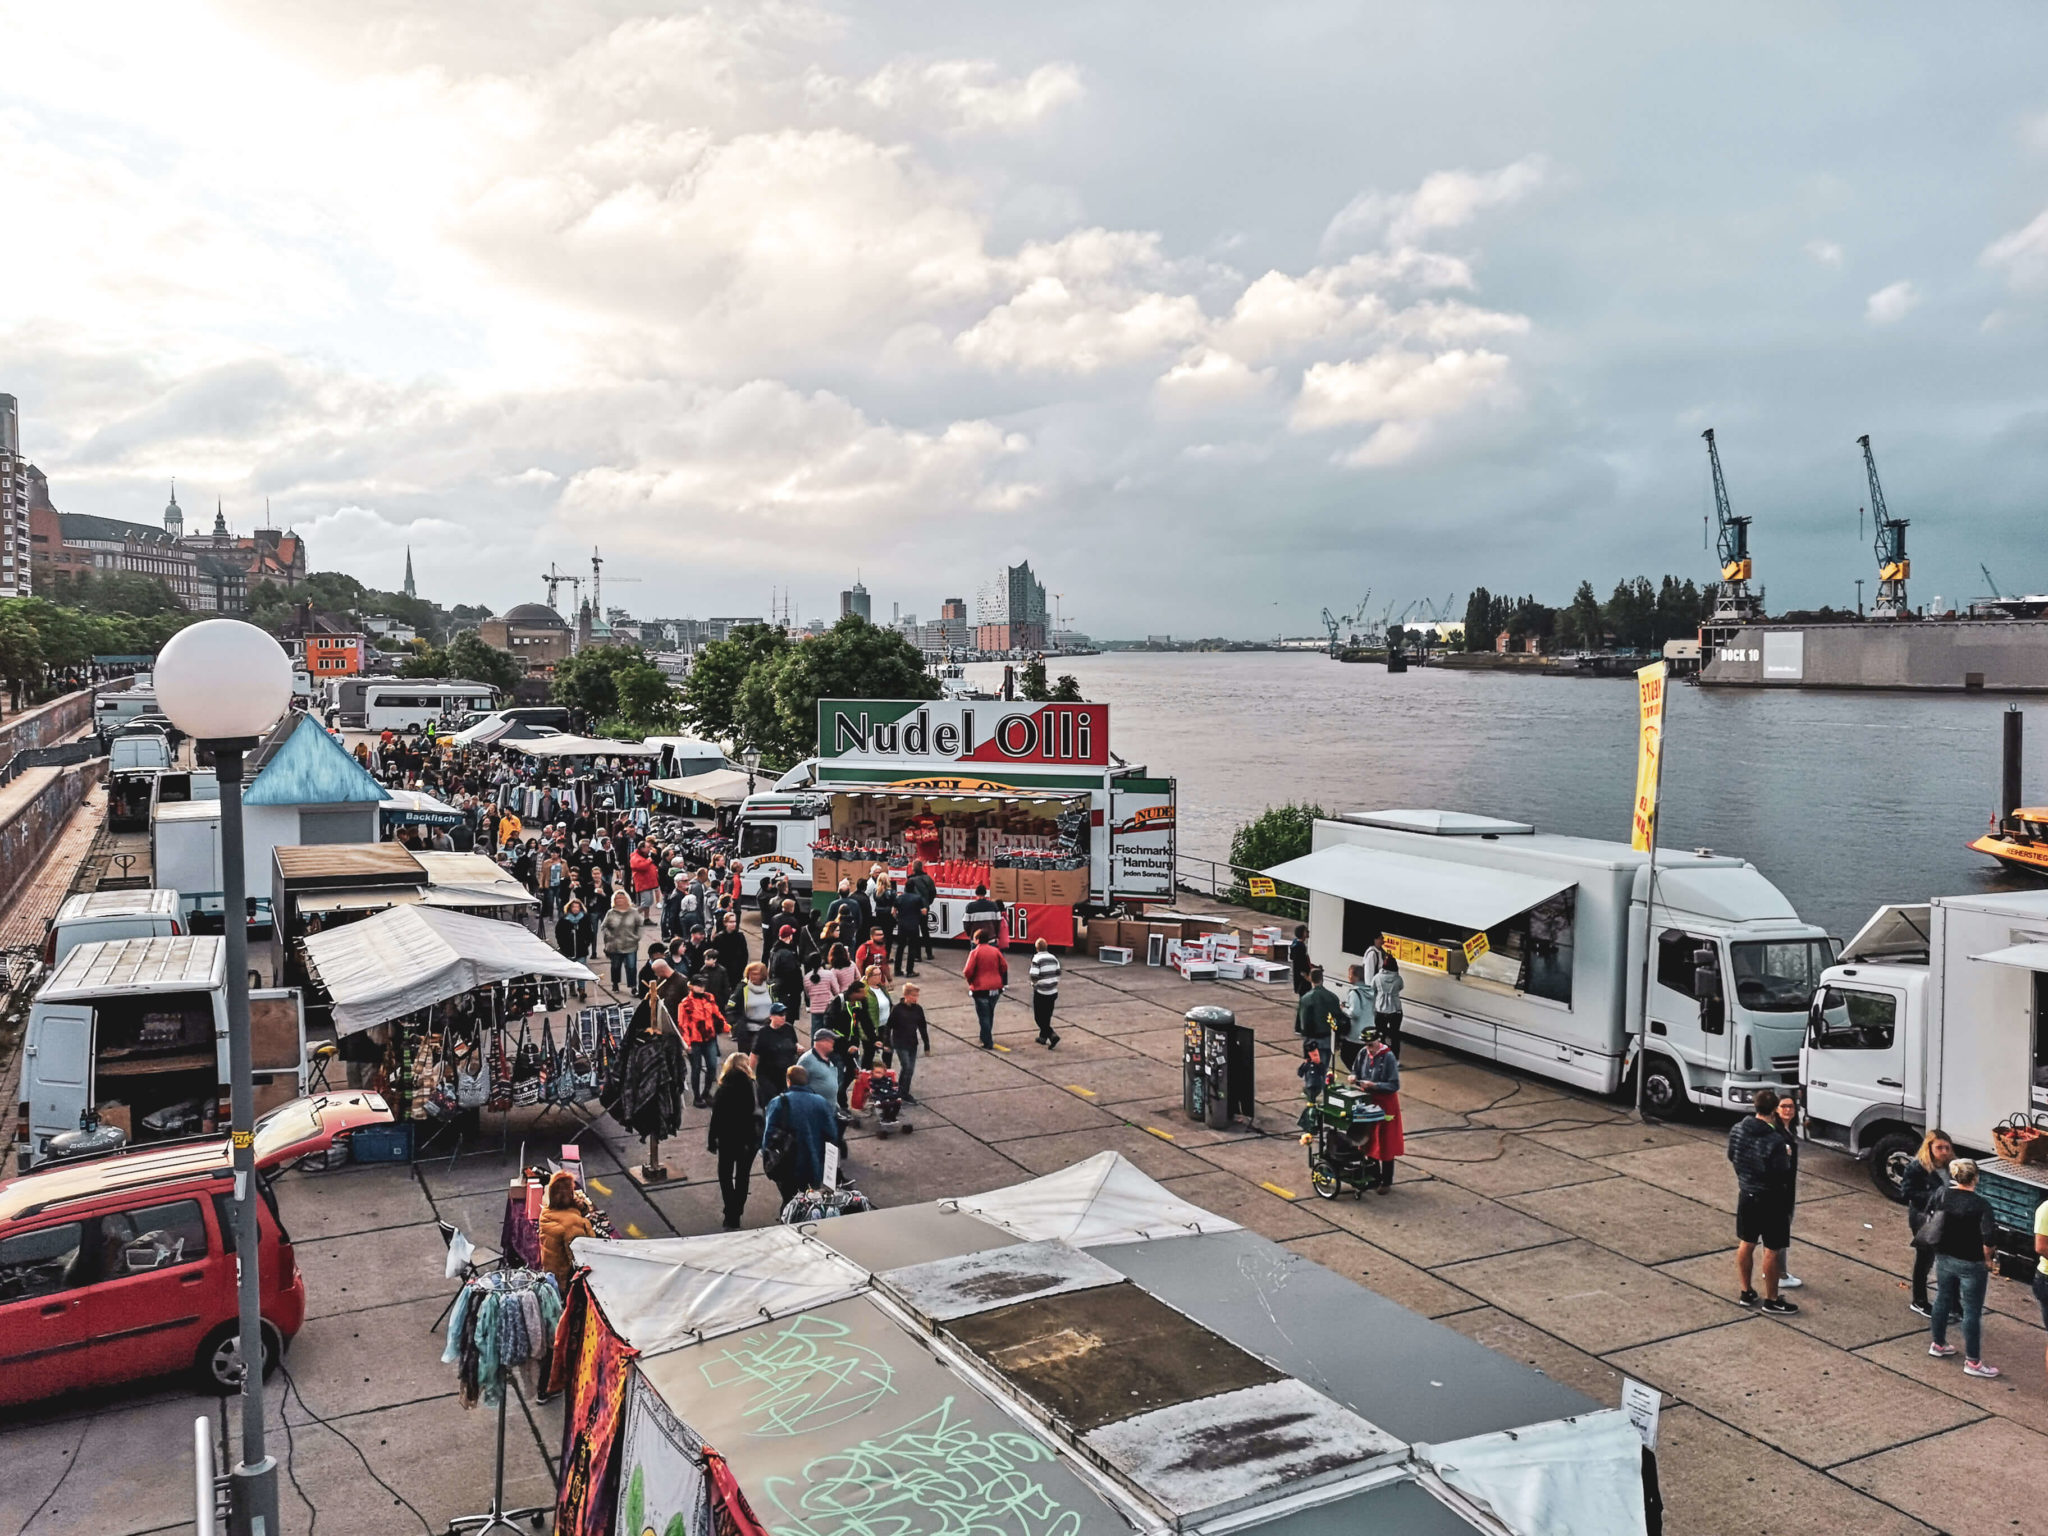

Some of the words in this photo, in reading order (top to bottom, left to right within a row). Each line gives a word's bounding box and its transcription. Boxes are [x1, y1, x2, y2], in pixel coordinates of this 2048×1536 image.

[1721, 648, 1746, 662] DOCK
[1748, 648, 1760, 662] 10
[834, 708, 976, 757] Nudel
[994, 710, 1093, 760] Olli
[405, 812, 455, 822] Backfisch
[1115, 844, 1173, 856] Fischmarkt
[1123, 857, 1173, 870] Hamburg
[1142, 870, 1169, 879] Sonntag
